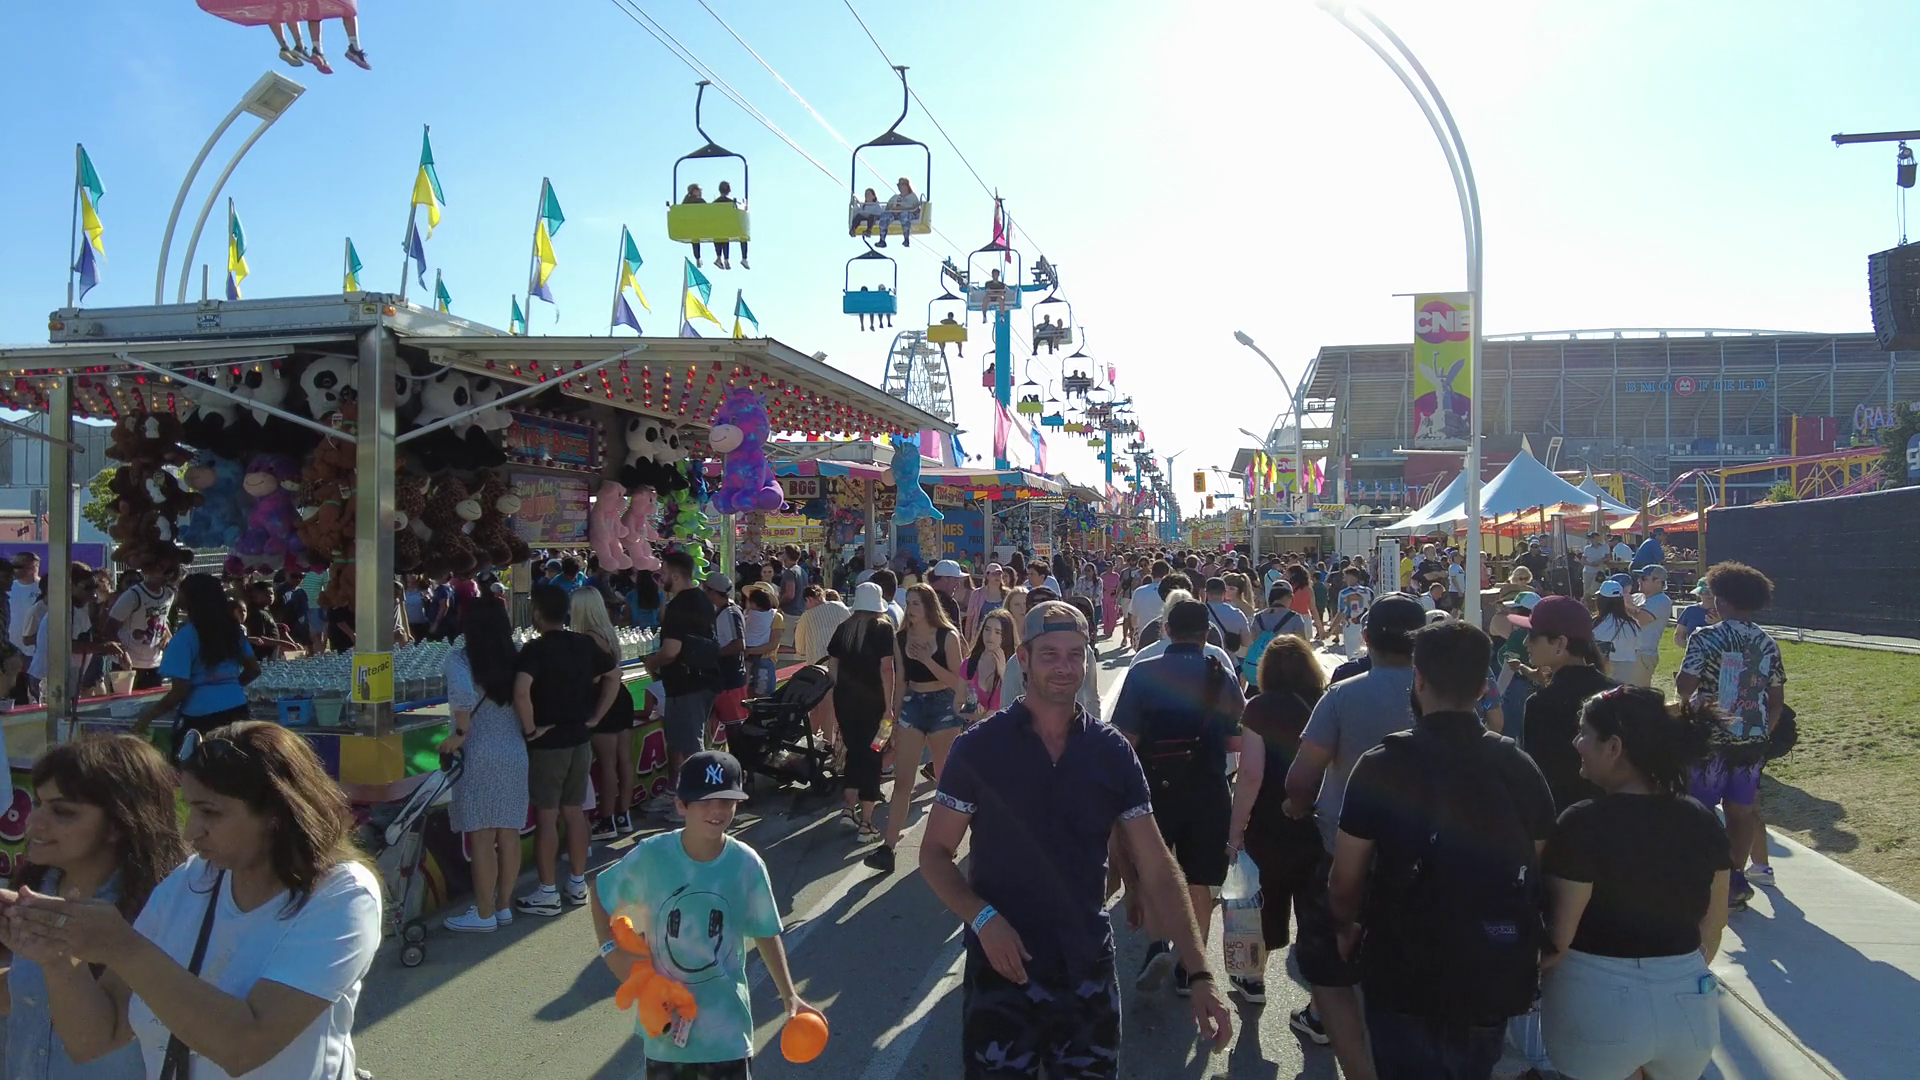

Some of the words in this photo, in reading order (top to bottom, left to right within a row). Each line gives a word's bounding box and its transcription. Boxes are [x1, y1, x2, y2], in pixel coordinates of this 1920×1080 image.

[1416, 310, 1471, 334] CNE
[1625, 380, 1673, 393] BMO
[1699, 378, 1767, 392] FIELD
[789, 480, 817, 496] BOG
[705, 763, 724, 785] NY
[1235, 941, 1245, 970] GD
